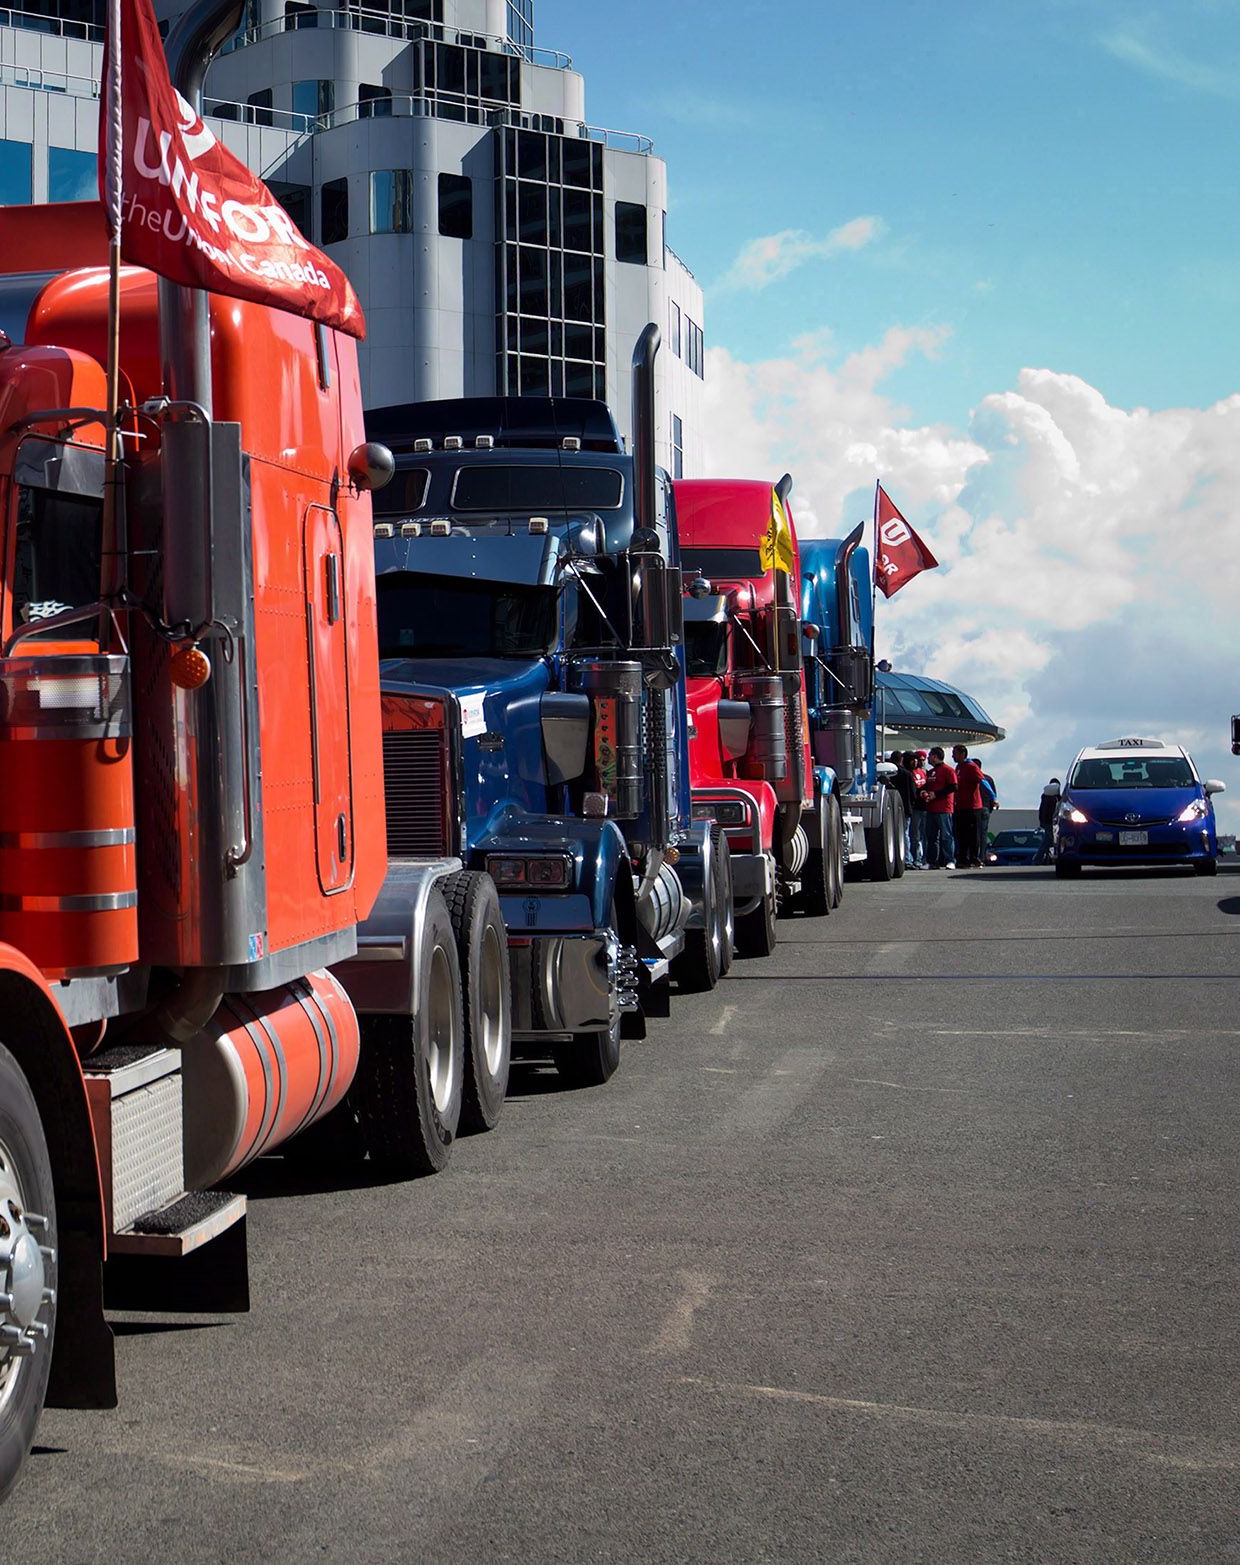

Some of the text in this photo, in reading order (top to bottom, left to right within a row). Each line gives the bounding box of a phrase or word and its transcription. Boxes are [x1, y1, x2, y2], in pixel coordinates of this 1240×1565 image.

[134, 117, 309, 249] UNFOR
[239, 251, 331, 290] Canada
[1118, 739, 1144, 747] TAXI
